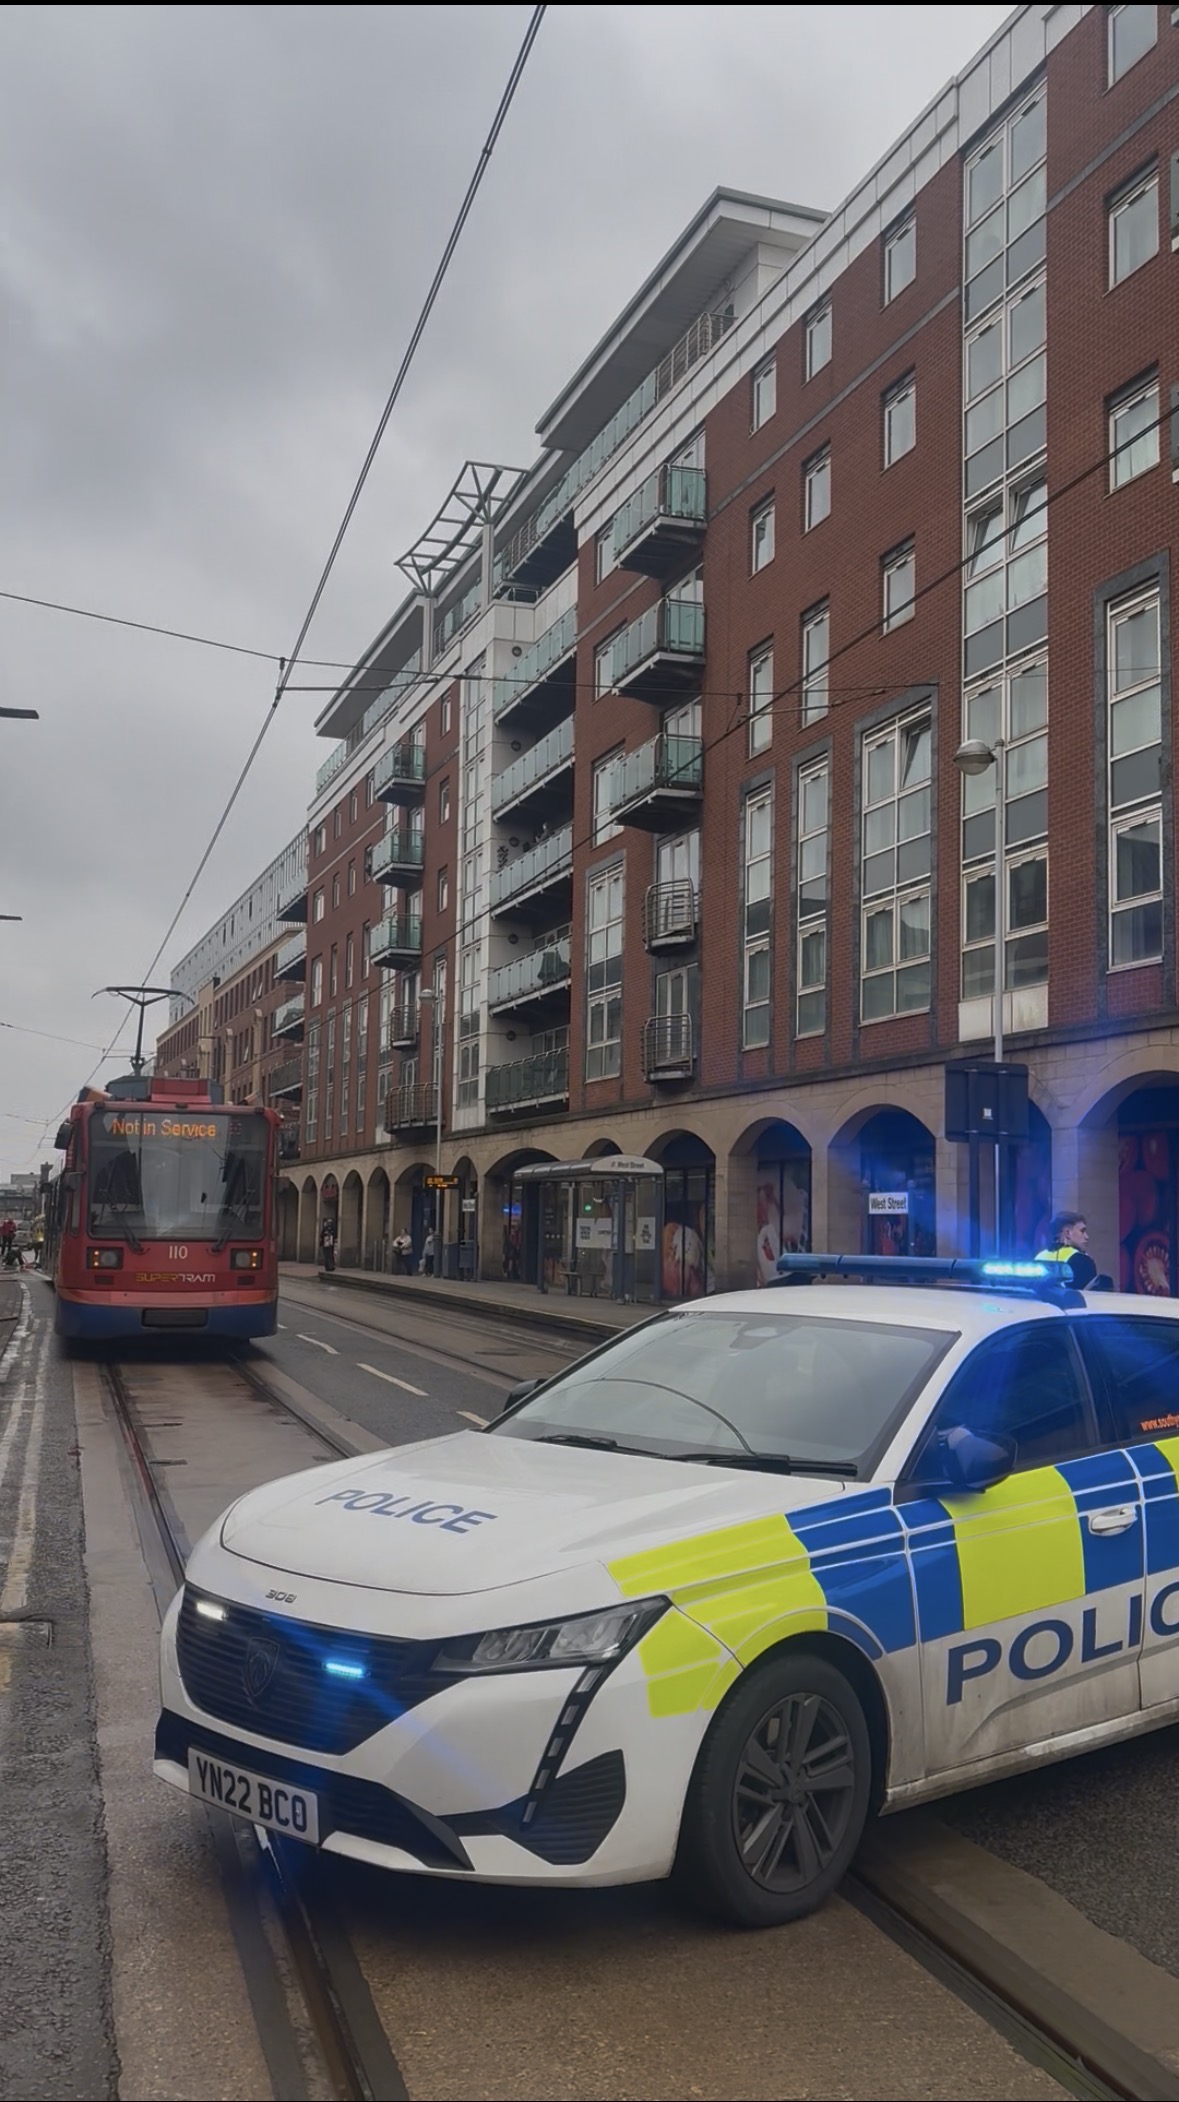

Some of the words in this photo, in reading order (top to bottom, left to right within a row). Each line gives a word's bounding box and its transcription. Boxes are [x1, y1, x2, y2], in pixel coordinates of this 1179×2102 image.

[112, 1118, 140, 1135] Not
[143, 1119, 156, 1136] in
[161, 1119, 216, 1137] Service
[870, 1197, 886, 1210] West
[888, 1196, 907, 1210] Street
[169, 1245, 188, 1260] 110
[136, 1273, 216, 1283] SUPERTRAM
[314, 1489, 498, 1534] POLICE
[265, 1589, 297, 1604] 308
[196, 1756, 252, 1814] YN22
[257, 1782, 307, 1832] BCO
